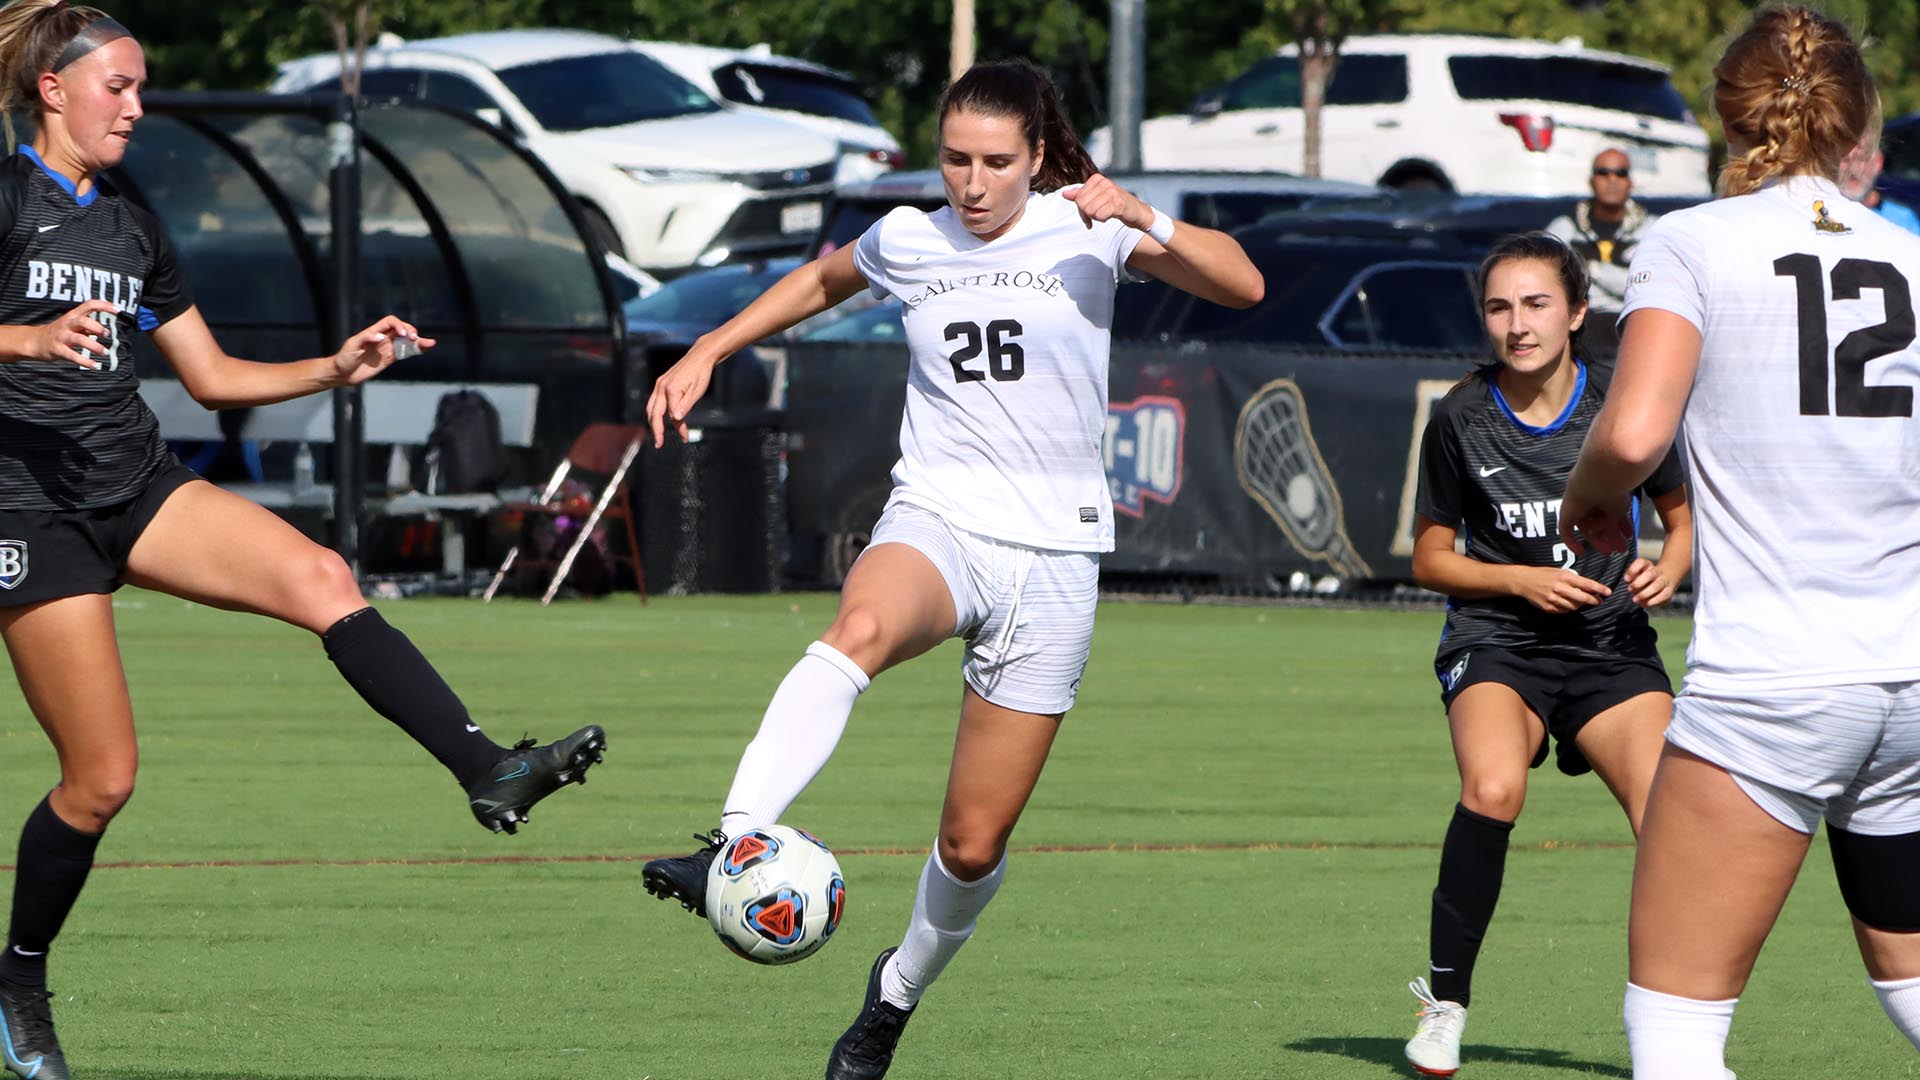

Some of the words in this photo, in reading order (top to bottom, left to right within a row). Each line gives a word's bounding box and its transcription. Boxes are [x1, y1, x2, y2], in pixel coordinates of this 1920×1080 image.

[26, 260, 144, 315] BENTLE
[908, 274, 988, 311] SAINT
[991, 271, 1065, 297] ROSE
[943, 319, 1025, 384] 26
[1772, 252, 1917, 418] 12
[0, 547, 22, 577] B
[1552, 543, 1580, 576] 2
